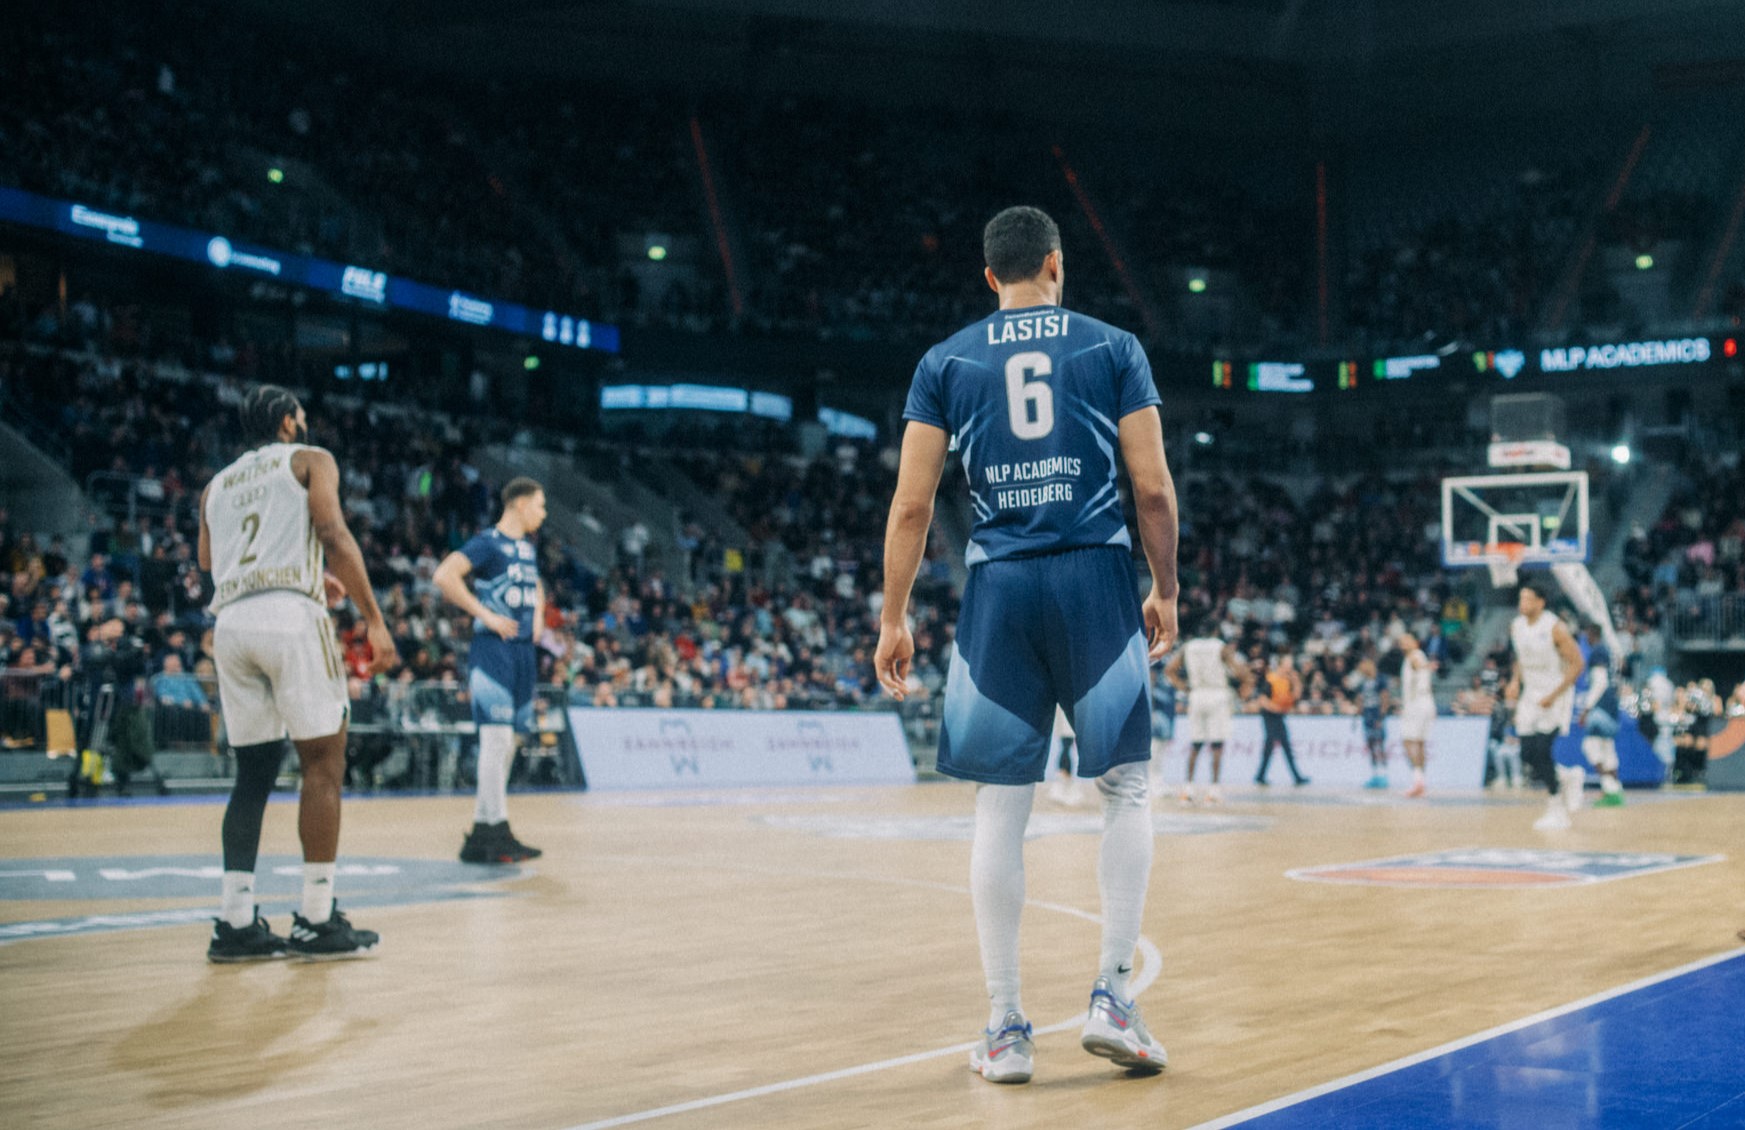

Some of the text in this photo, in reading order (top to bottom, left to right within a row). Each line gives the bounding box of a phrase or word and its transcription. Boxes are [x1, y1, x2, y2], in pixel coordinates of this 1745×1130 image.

[987, 314, 1069, 345] LASISI
[1541, 337, 1711, 372] MLP ACADEMICS
[1005, 351, 1055, 441] 6
[1013, 456, 1081, 481] ACADEMICS
[997, 483, 1073, 510] HEIDELBERG
[238, 512, 261, 566] 2
